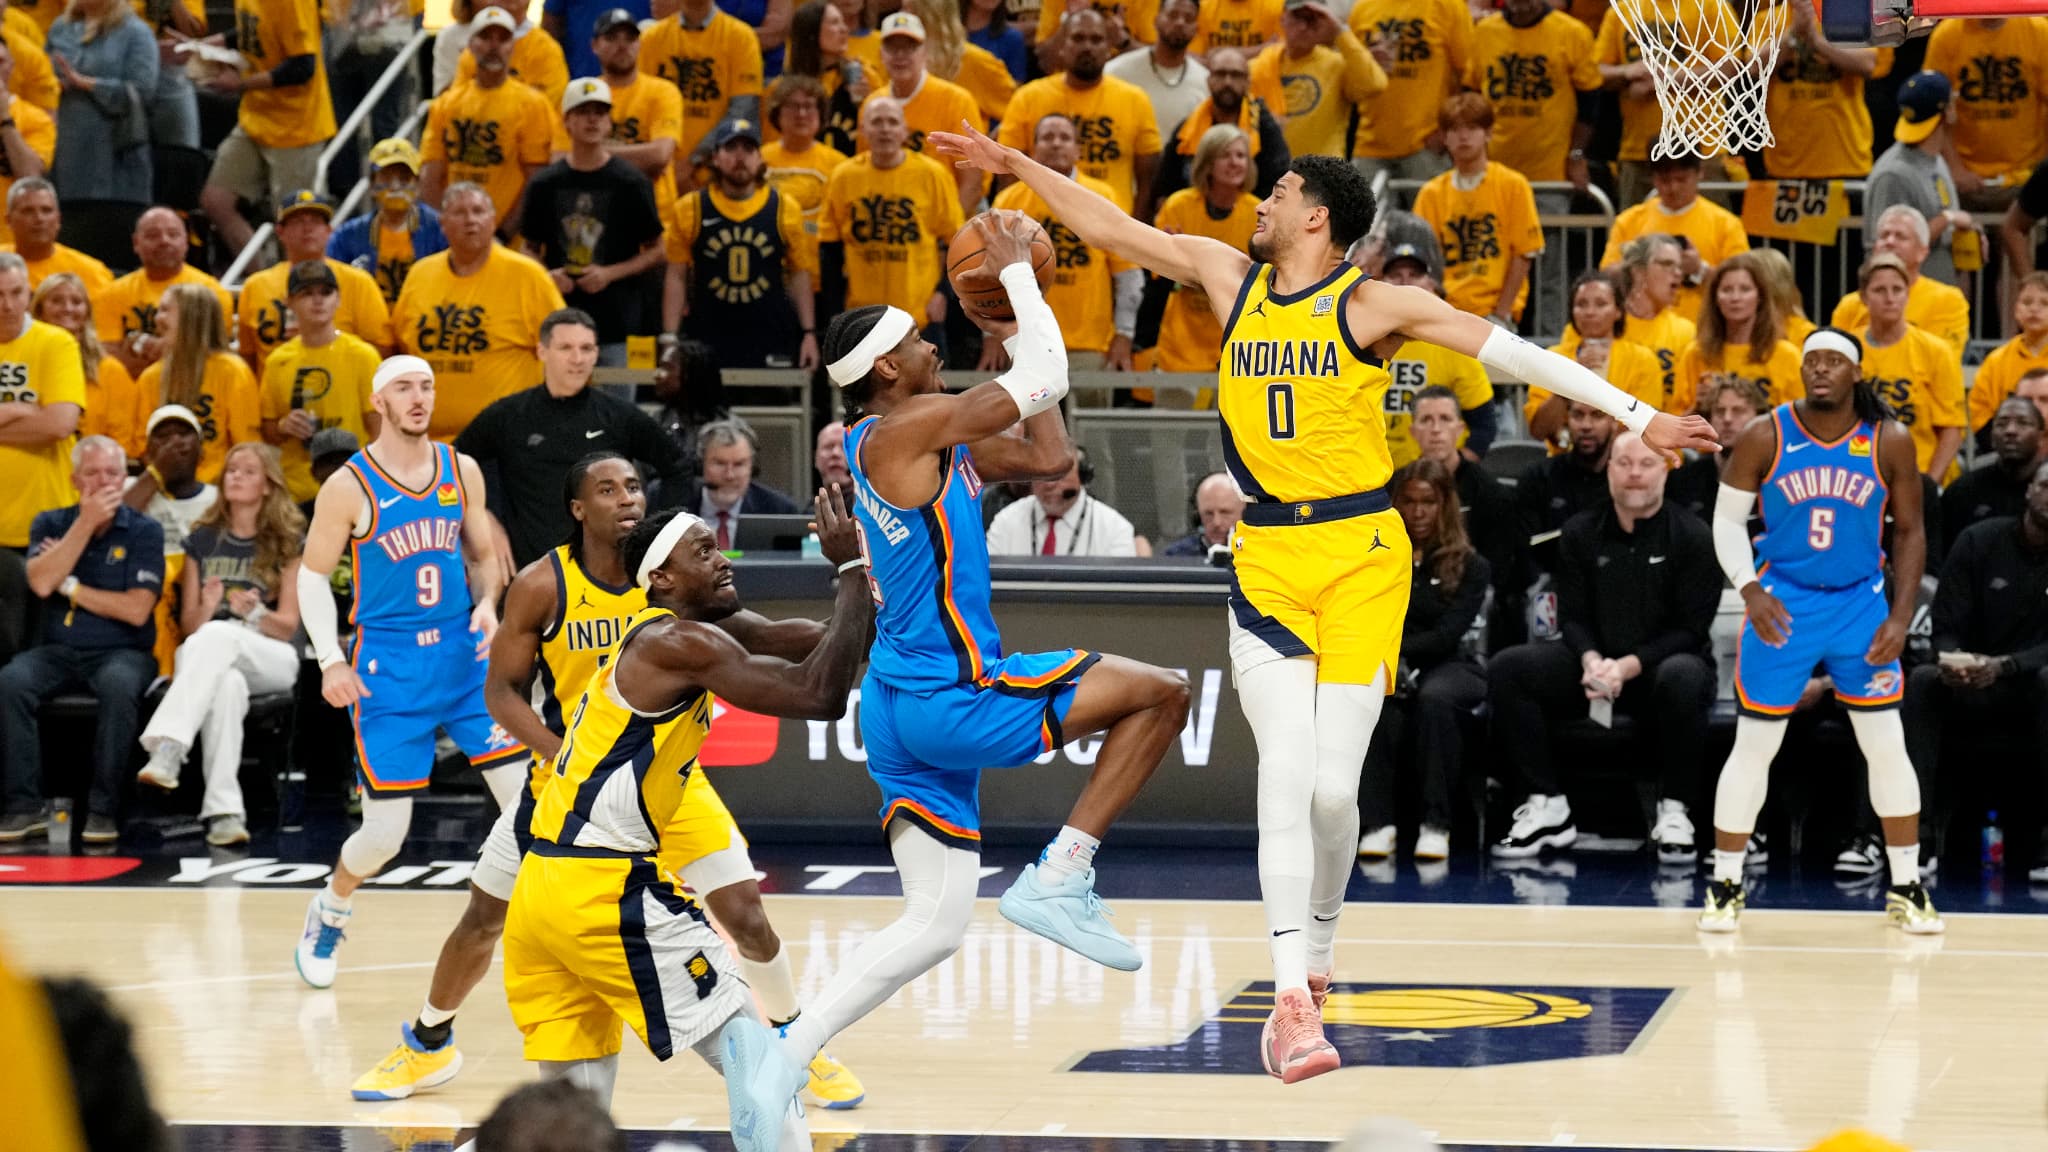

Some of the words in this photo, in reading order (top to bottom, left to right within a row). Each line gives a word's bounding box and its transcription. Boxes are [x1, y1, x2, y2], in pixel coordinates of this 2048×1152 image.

[1499, 53, 1547, 77] YES
[860, 194, 915, 222] YES
[728, 245, 750, 283] 0
[434, 303, 485, 331] YES
[1231, 341, 1340, 377] INDIANA
[1267, 382, 1297, 441] 0
[1776, 465, 1876, 508] THUNDER
[1809, 508, 1835, 550] 5
[416, 563, 442, 608] 9
[416, 629, 441, 647] OKC
